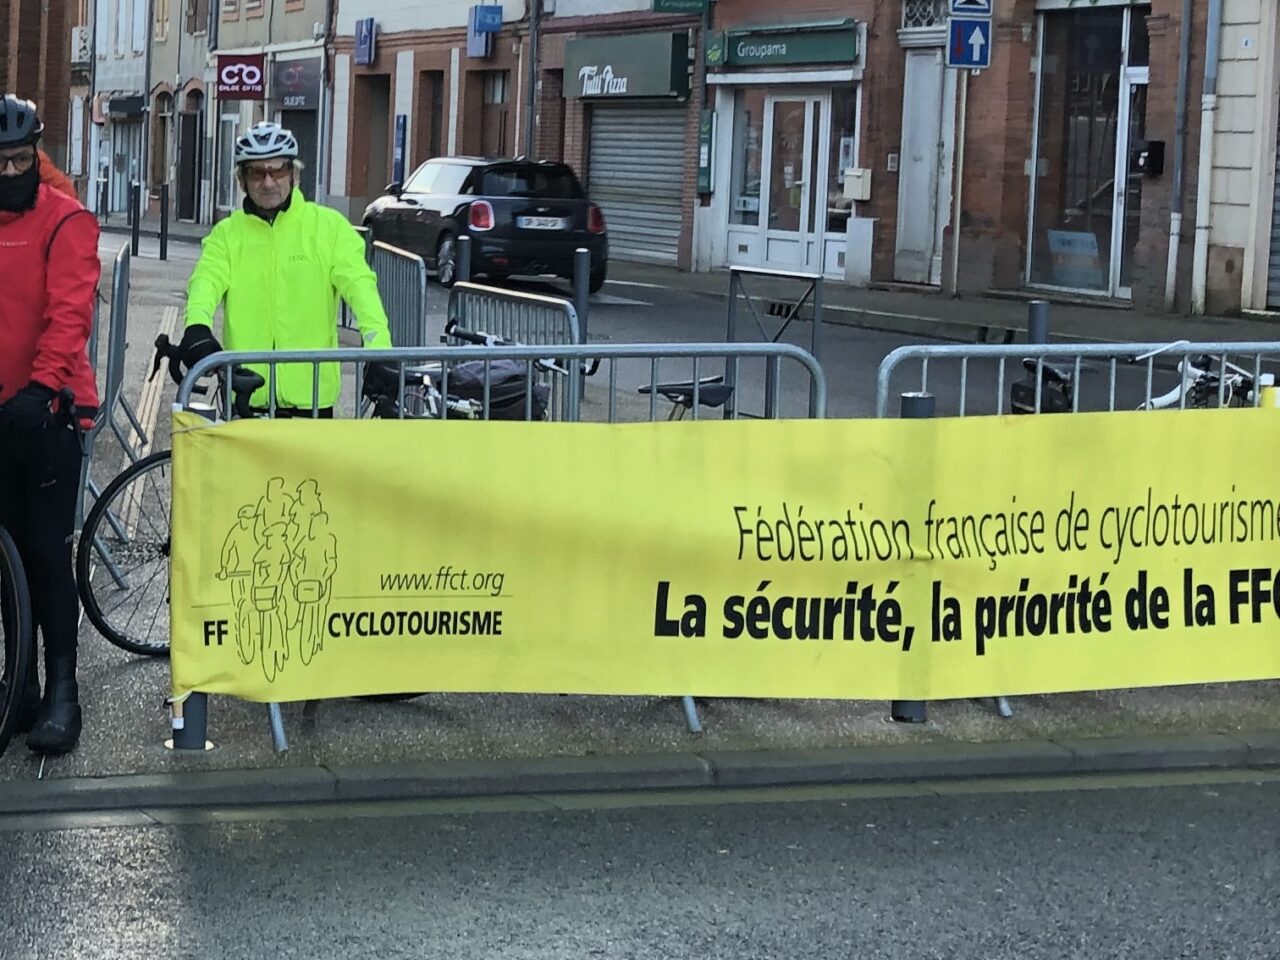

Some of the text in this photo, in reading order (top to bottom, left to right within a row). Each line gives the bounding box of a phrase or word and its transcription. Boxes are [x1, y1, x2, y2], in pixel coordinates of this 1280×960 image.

[736, 42, 787, 58] Groupama
[602, 65, 628, 95] Pizza
[733, 484, 1280, 571] Fédération française de cyclotourism
[379, 565, 506, 597] www.ffct.org
[203, 610, 503, 646] FF CYCLOTOURISME
[654, 581, 708, 638] La
[722, 580, 915, 651] sécurité,
[931, 580, 962, 642] la
[975, 572, 1112, 655] priorité
[1125, 570, 1170, 631] de
[1183, 568, 1216, 627] la
